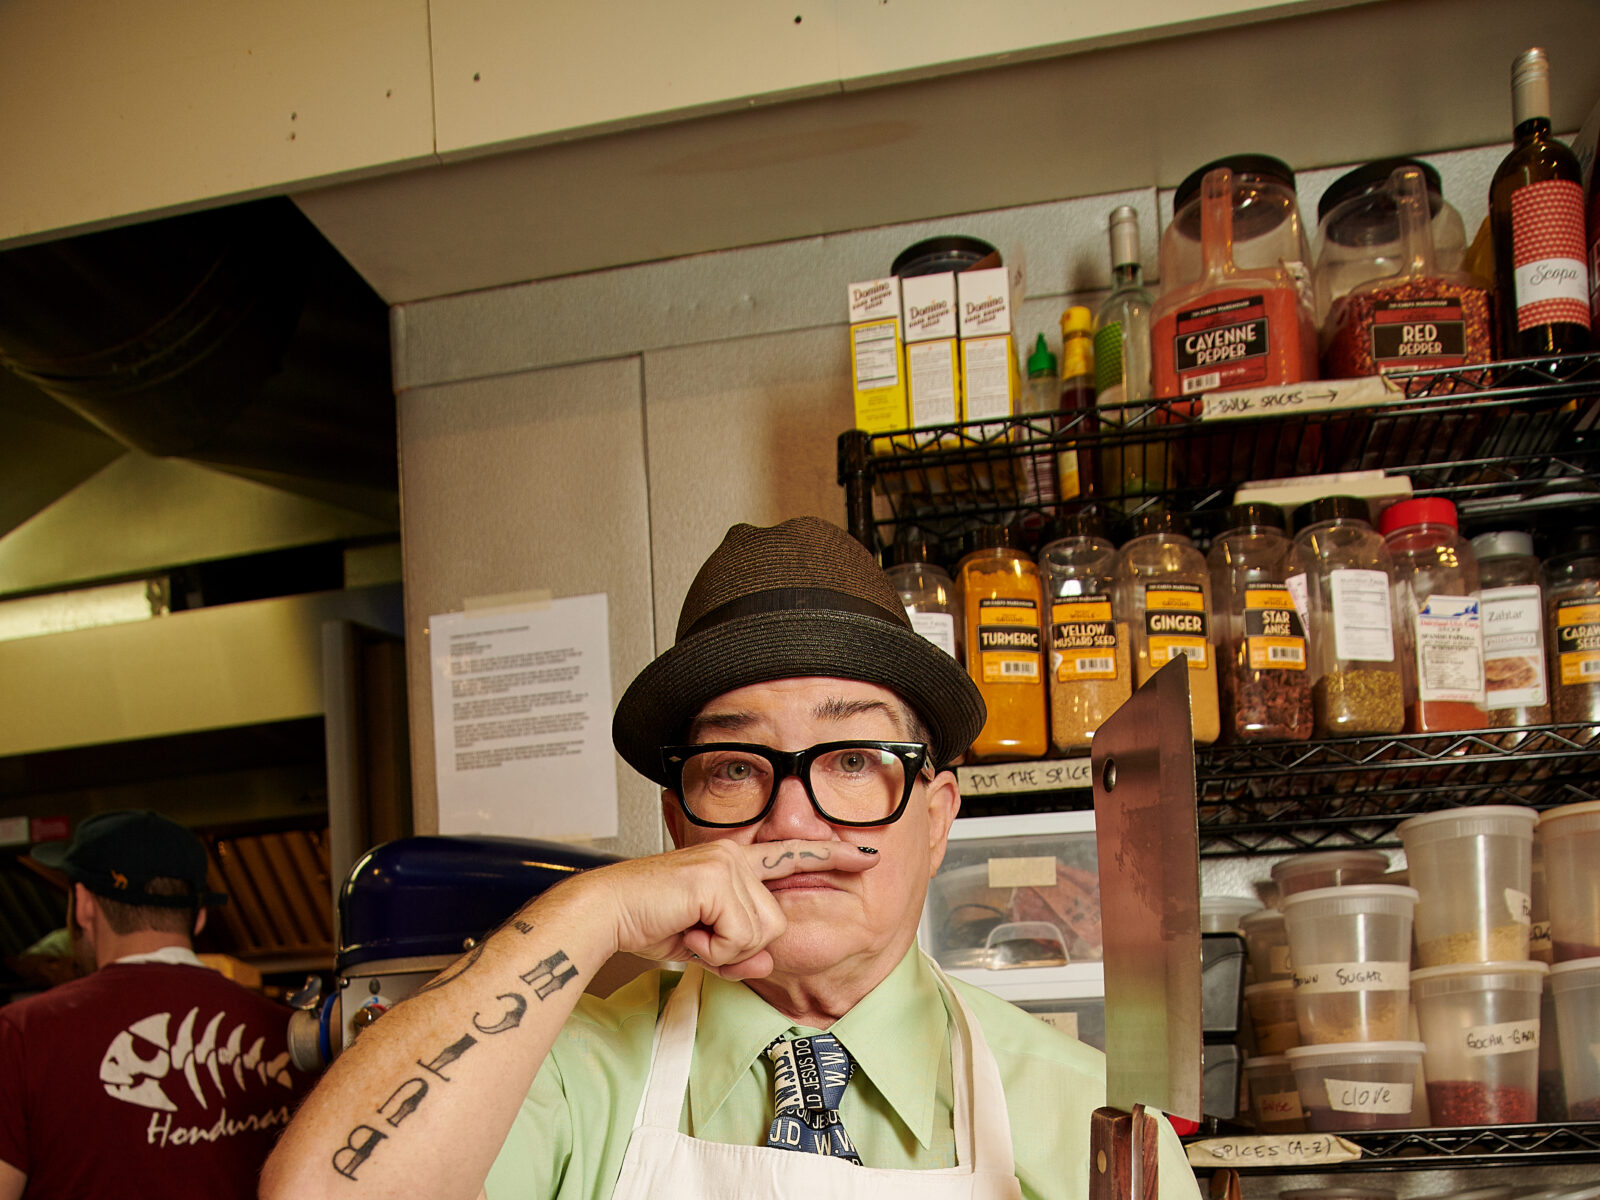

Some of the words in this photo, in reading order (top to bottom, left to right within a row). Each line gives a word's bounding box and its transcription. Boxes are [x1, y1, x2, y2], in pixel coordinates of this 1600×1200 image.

[1530, 264, 1579, 286] Scopa
[853, 281, 890, 302] Domino
[909, 299, 948, 320] Domino
[965, 295, 1004, 317] Domino
[1185, 323, 1257, 354] CAYENNE
[1402, 324, 1438, 343] RED
[1196, 343, 1247, 365] PEPPER
[1398, 342, 1442, 357] PEPPER
[1150, 614, 1202, 632] GINGER
[1261, 611, 1291, 624] STAR
[1060, 623, 1107, 638] YELLOW
[1263, 623, 1291, 635] ANISE
[981, 631, 1039, 648] TURMERIC
[1053, 636, 1093, 649] MUSTARD
[1094, 635, 1116, 646] SEED
[970, 772, 999, 793] PUT
[1007, 770, 1038, 786] THE
[1336, 968, 1382, 986] SUGAR
[794, 1038, 810, 1056] DO
[332, 950, 579, 1181] BUTCH
[798, 1057, 820, 1090] JESUS
[812, 1110, 841, 1129] JESU
[1211, 1144, 1280, 1159] SPICES
[1288, 1136, 1332, 1157] (A-Z)
